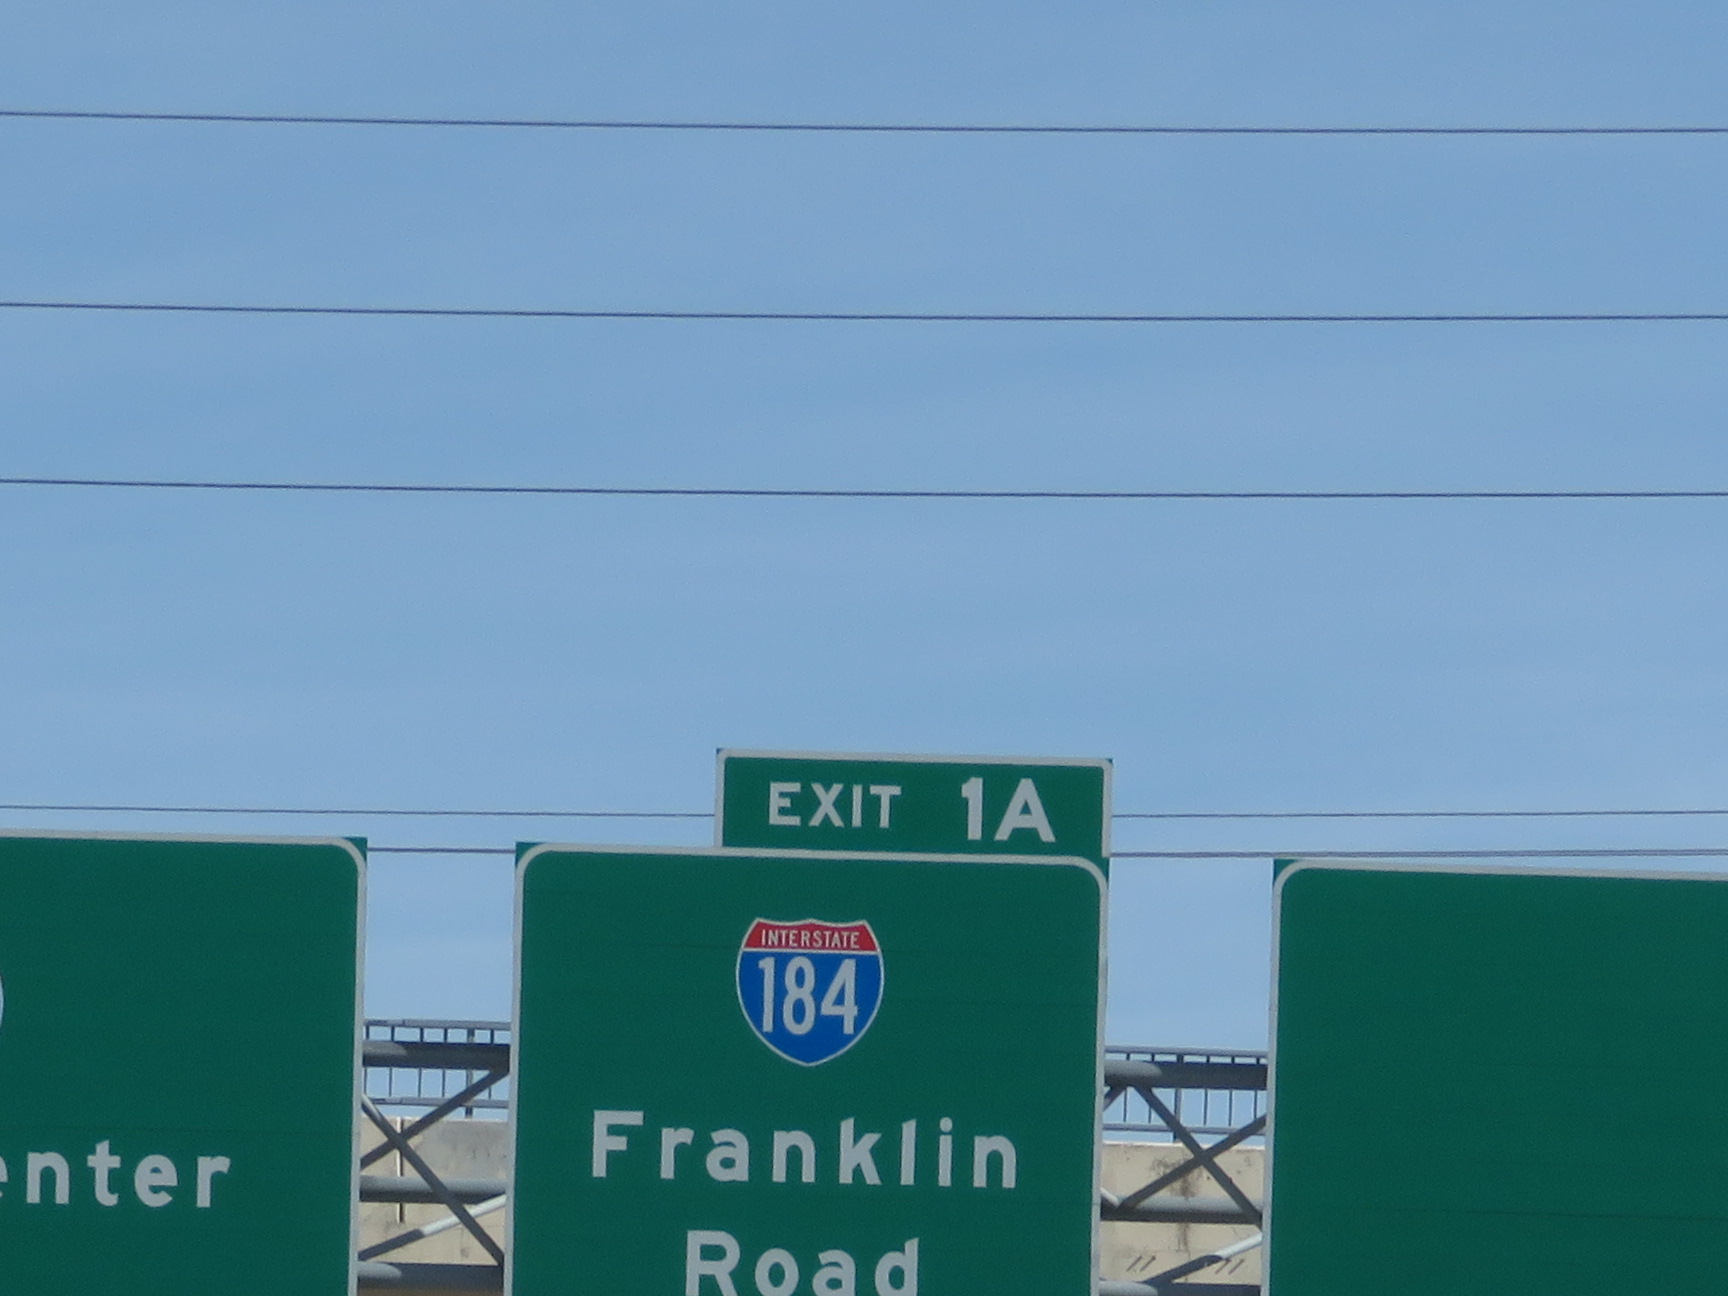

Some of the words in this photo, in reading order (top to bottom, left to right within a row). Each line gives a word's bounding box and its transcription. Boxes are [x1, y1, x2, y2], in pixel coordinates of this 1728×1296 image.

[768, 781, 902, 829] EXIT
[961, 777, 1056, 842] 1A
[760, 928, 861, 950] INTERSTATE
[758, 955, 859, 1036] 184
[592, 1110, 1017, 1189] Franklin
